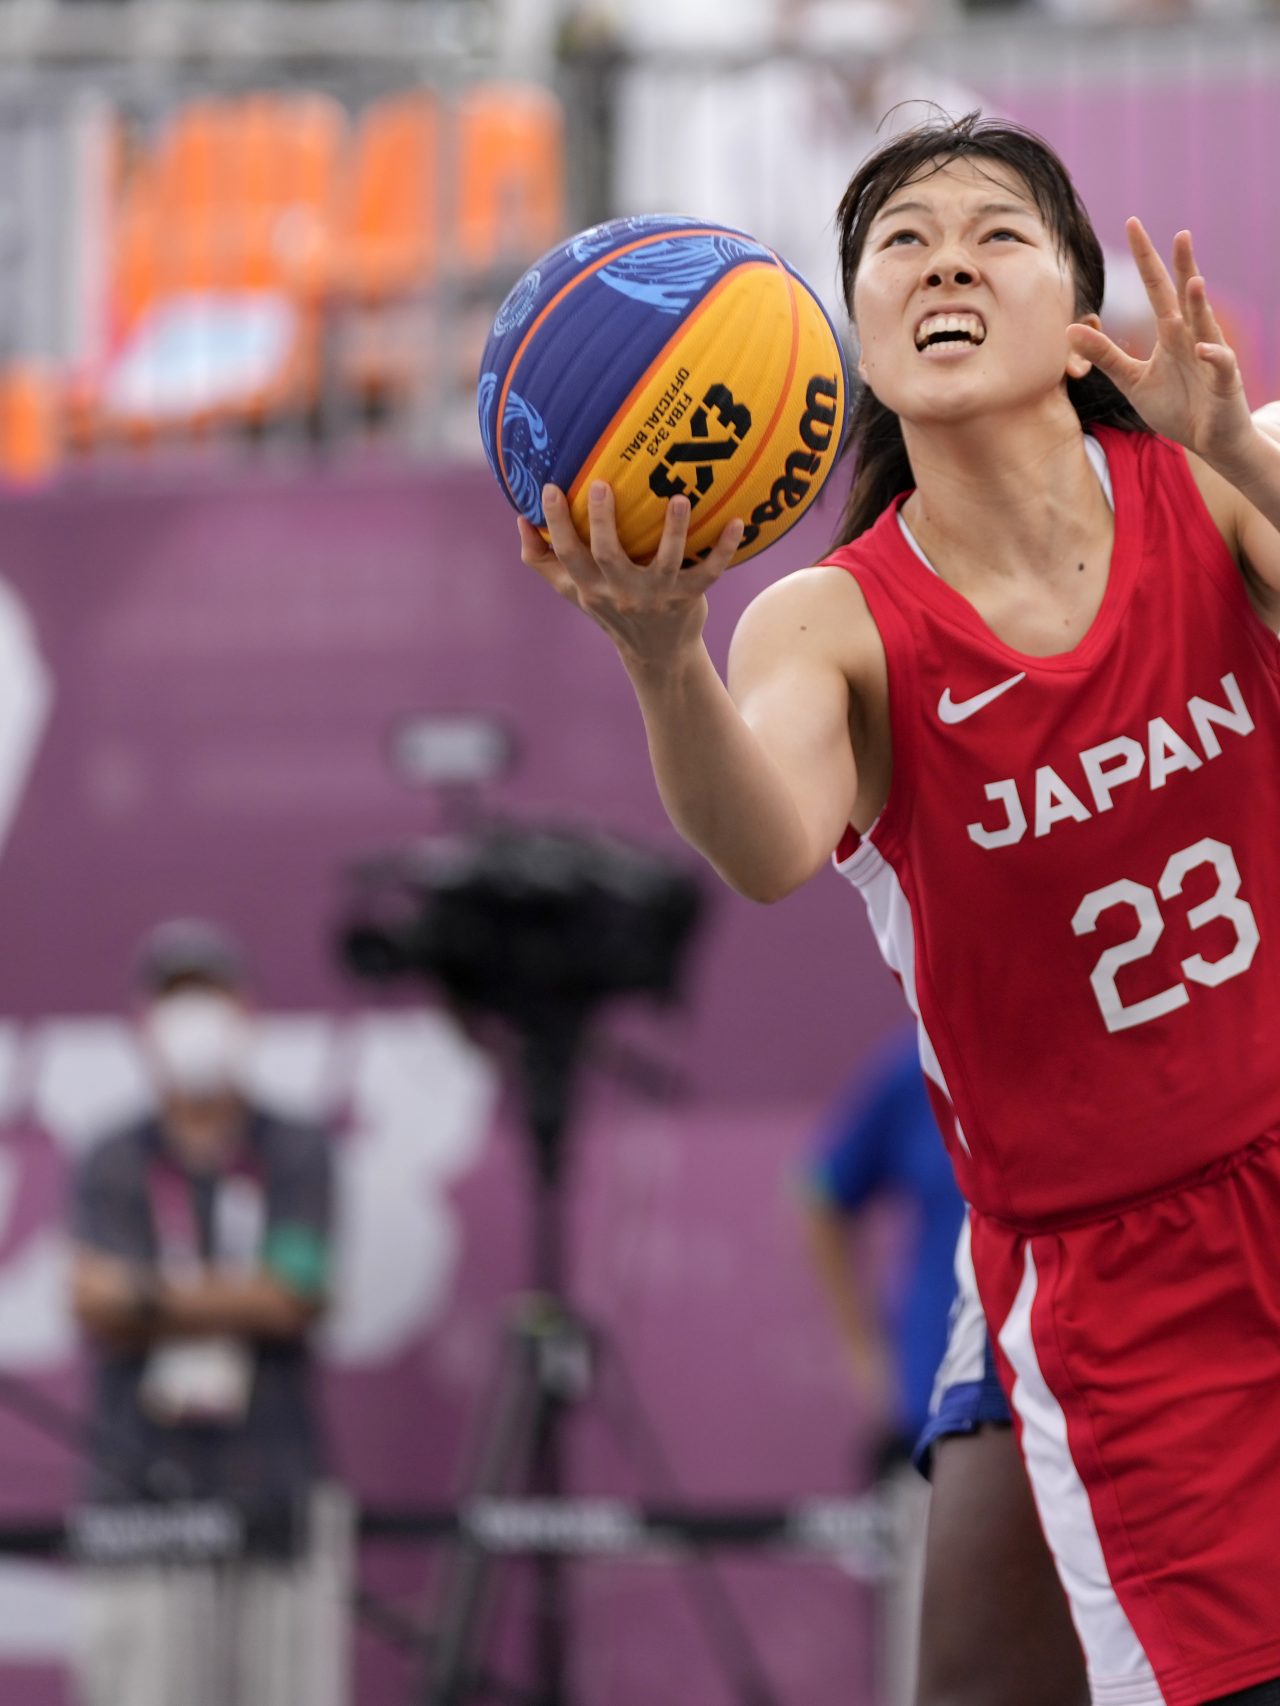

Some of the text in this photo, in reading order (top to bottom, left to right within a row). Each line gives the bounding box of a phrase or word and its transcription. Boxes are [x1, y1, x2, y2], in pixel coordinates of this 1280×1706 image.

[619, 367, 690, 462] OFFICIAL BALL
[665, 392, 693, 428] FIBA
[966, 672, 1256, 850] JAPAN
[1070, 837, 1260, 1034] 23
